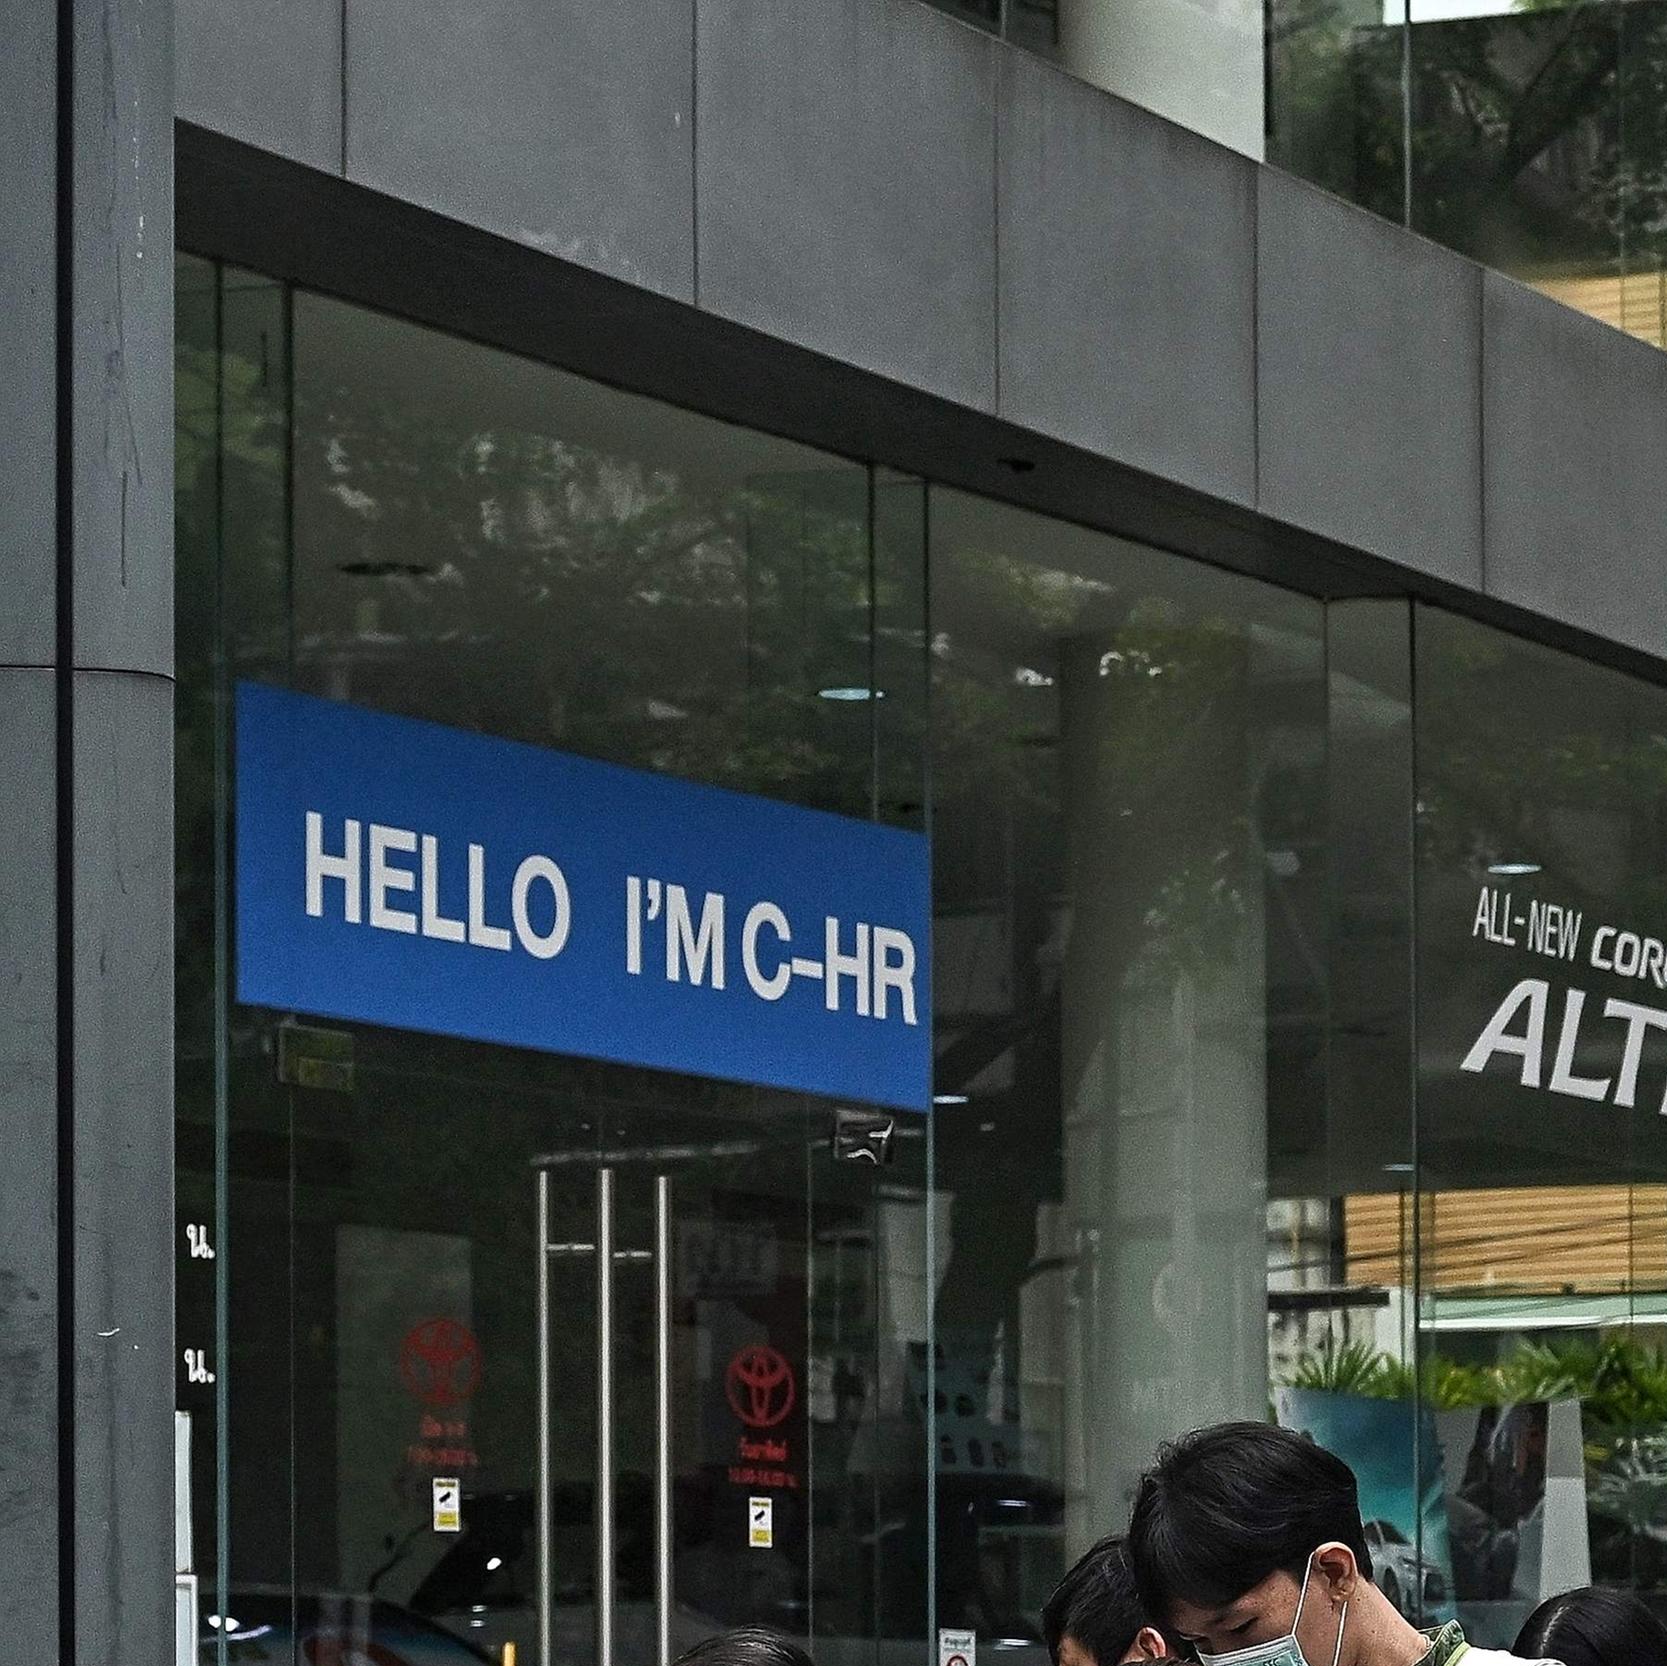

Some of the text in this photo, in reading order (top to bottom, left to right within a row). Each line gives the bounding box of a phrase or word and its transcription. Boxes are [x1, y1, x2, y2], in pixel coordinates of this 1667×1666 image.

[305, 810, 571, 960] HELLO
[741, 901, 918, 1025] C-HR
[1472, 886, 1581, 962] ALL-NEW
